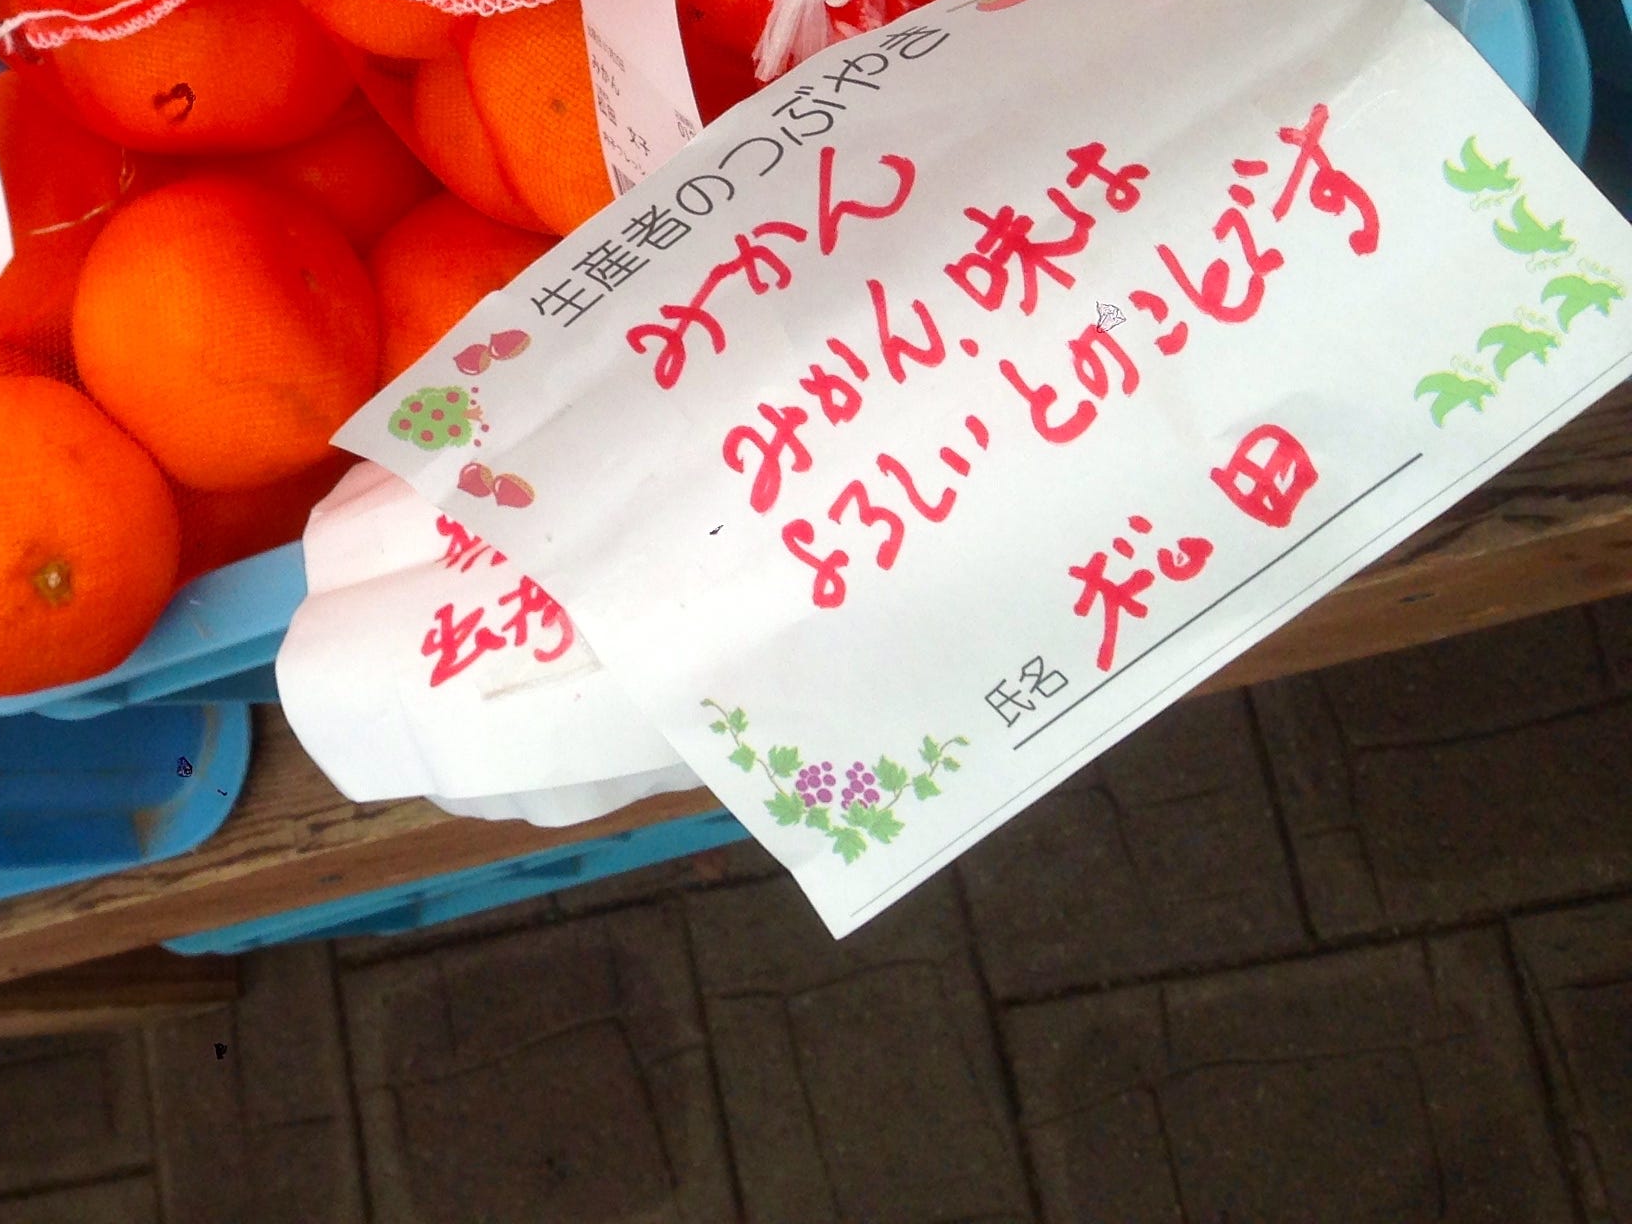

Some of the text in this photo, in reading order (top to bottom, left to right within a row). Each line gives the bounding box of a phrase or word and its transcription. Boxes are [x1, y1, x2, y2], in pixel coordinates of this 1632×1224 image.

[530, 25, 951, 328] 生産者のつぶやき
[625, 145, 917, 391] みかん
[780, 101, 1381, 609] よろしいとのことです
[984, 655, 1069, 728] 氏名
